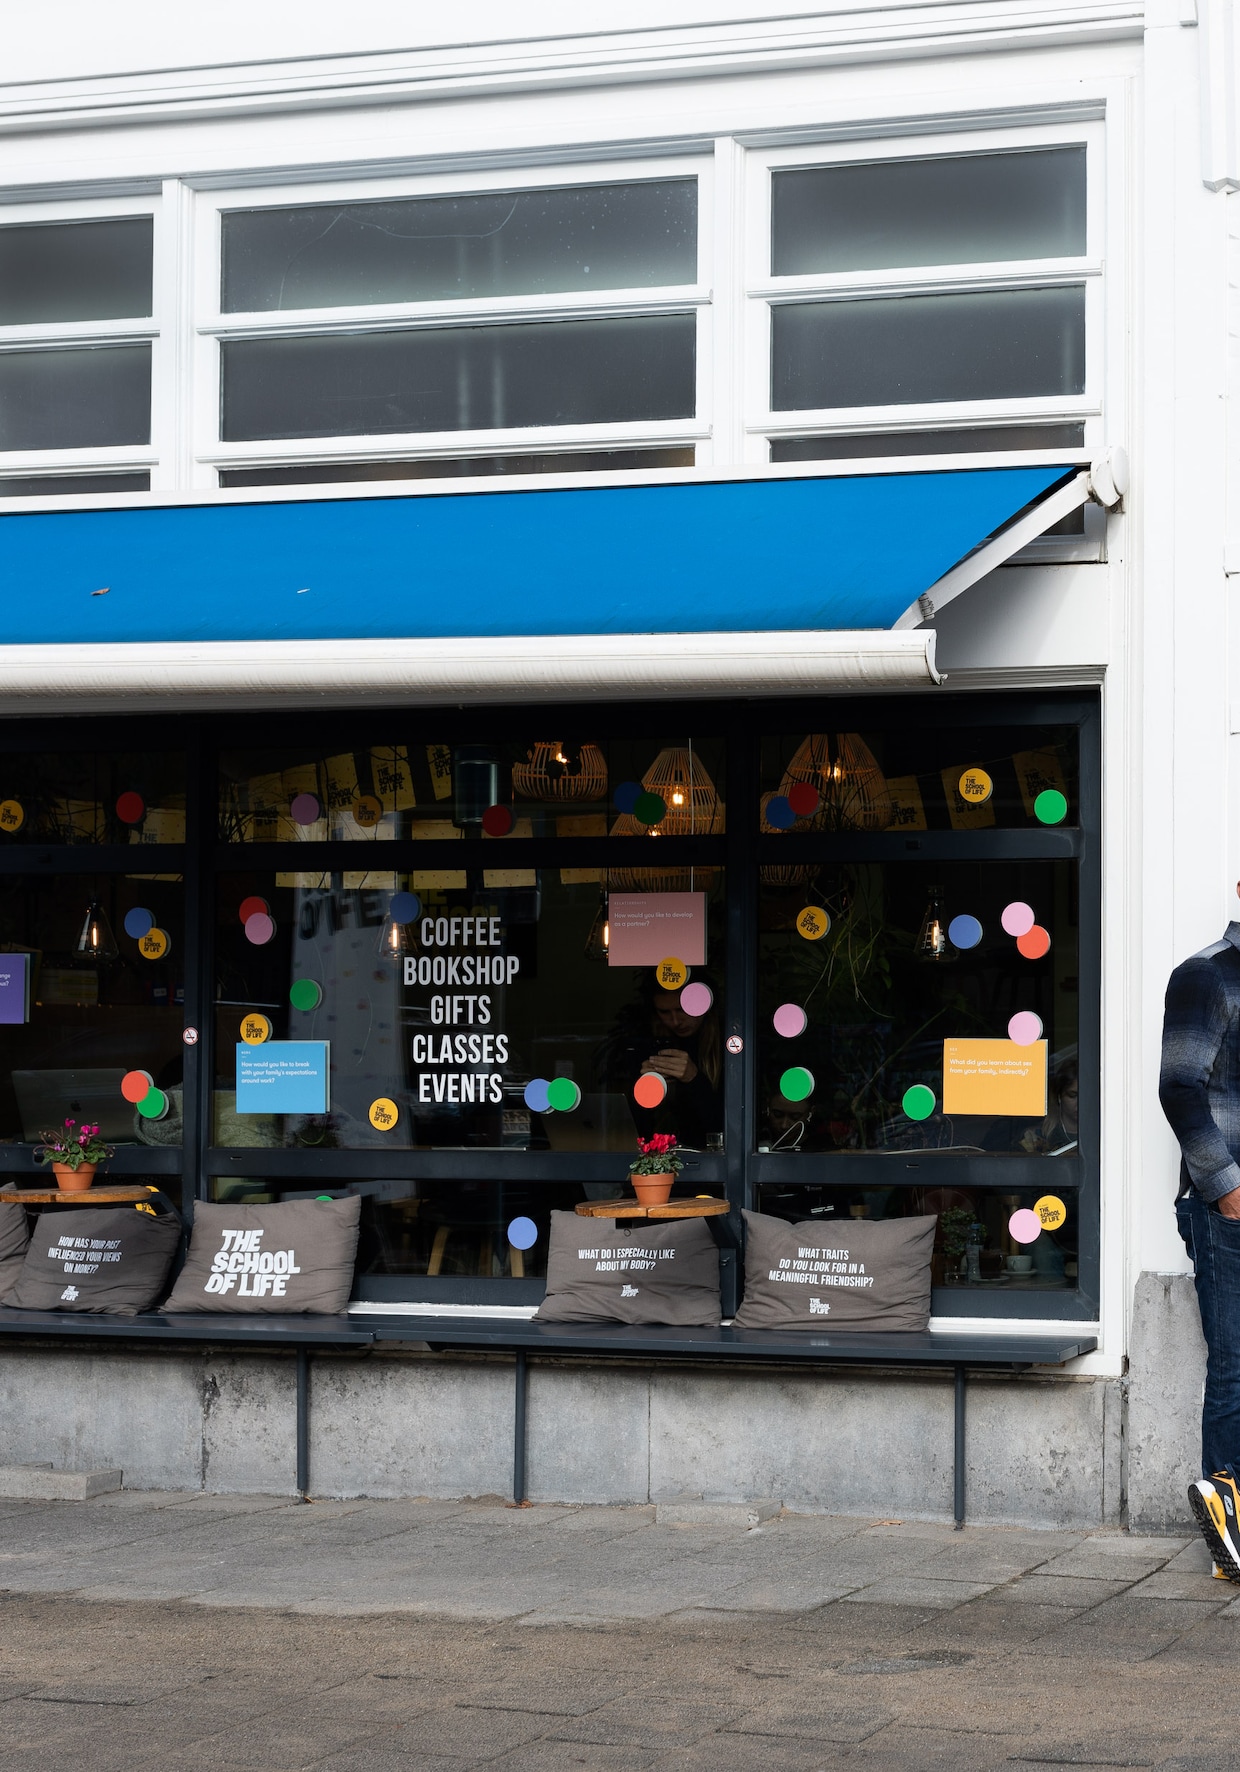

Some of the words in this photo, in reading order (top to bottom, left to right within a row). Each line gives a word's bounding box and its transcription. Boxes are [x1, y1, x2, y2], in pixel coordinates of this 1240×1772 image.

[421, 916, 502, 947] COFFEE
[403, 955, 520, 986] BOOKSHOP
[430, 995, 491, 1025] GIFTS
[412, 1034, 509, 1064] CLASSES
[419, 1073, 503, 1104] EVENTS
[375, 1111, 392, 1120] SCHOOL
[58, 1236, 75, 1247] HOW
[75, 1238, 90, 1248] HAS
[89, 1240, 106, 1249] YOUR
[104, 1240, 121, 1249] PAST
[220, 1229, 264, 1252] THE
[47, 1248, 86, 1261] INFLUENCED
[86, 1251, 103, 1262] YOUR
[103, 1252, 122, 1262] VIEWS
[210, 1250, 301, 1274] SCHOOL
[578, 1248, 600, 1259] WHAT
[601, 1248, 611, 1259] DO
[613, 1248, 616, 1258] I
[617, 1247, 658, 1260] ESPECIALLY
[658, 1249, 675, 1259] LIKE
[798, 1247, 820, 1259] WHAT
[821, 1248, 849, 1260] TRAITS
[64, 1262, 74, 1273] ON
[74, 1263, 99, 1274] MONEY?
[595, 1260, 620, 1271] ABOUT
[620, 1260, 630, 1270] MY
[630, 1260, 656, 1271] BODY?
[779, 1258, 791, 1269] DO
[792, 1260, 808, 1271] YOU
[809, 1261, 831, 1272] LOOK
[831, 1262, 847, 1273] FOR
[848, 1263, 858, 1274] IN
[859, 1264, 865, 1274] A
[204, 1273, 238, 1295] OF
[237, 1273, 291, 1297] LIFE
[768, 1270, 819, 1284] MEANINGFUL
[821, 1274, 874, 1288] FRIENDSHIP?
